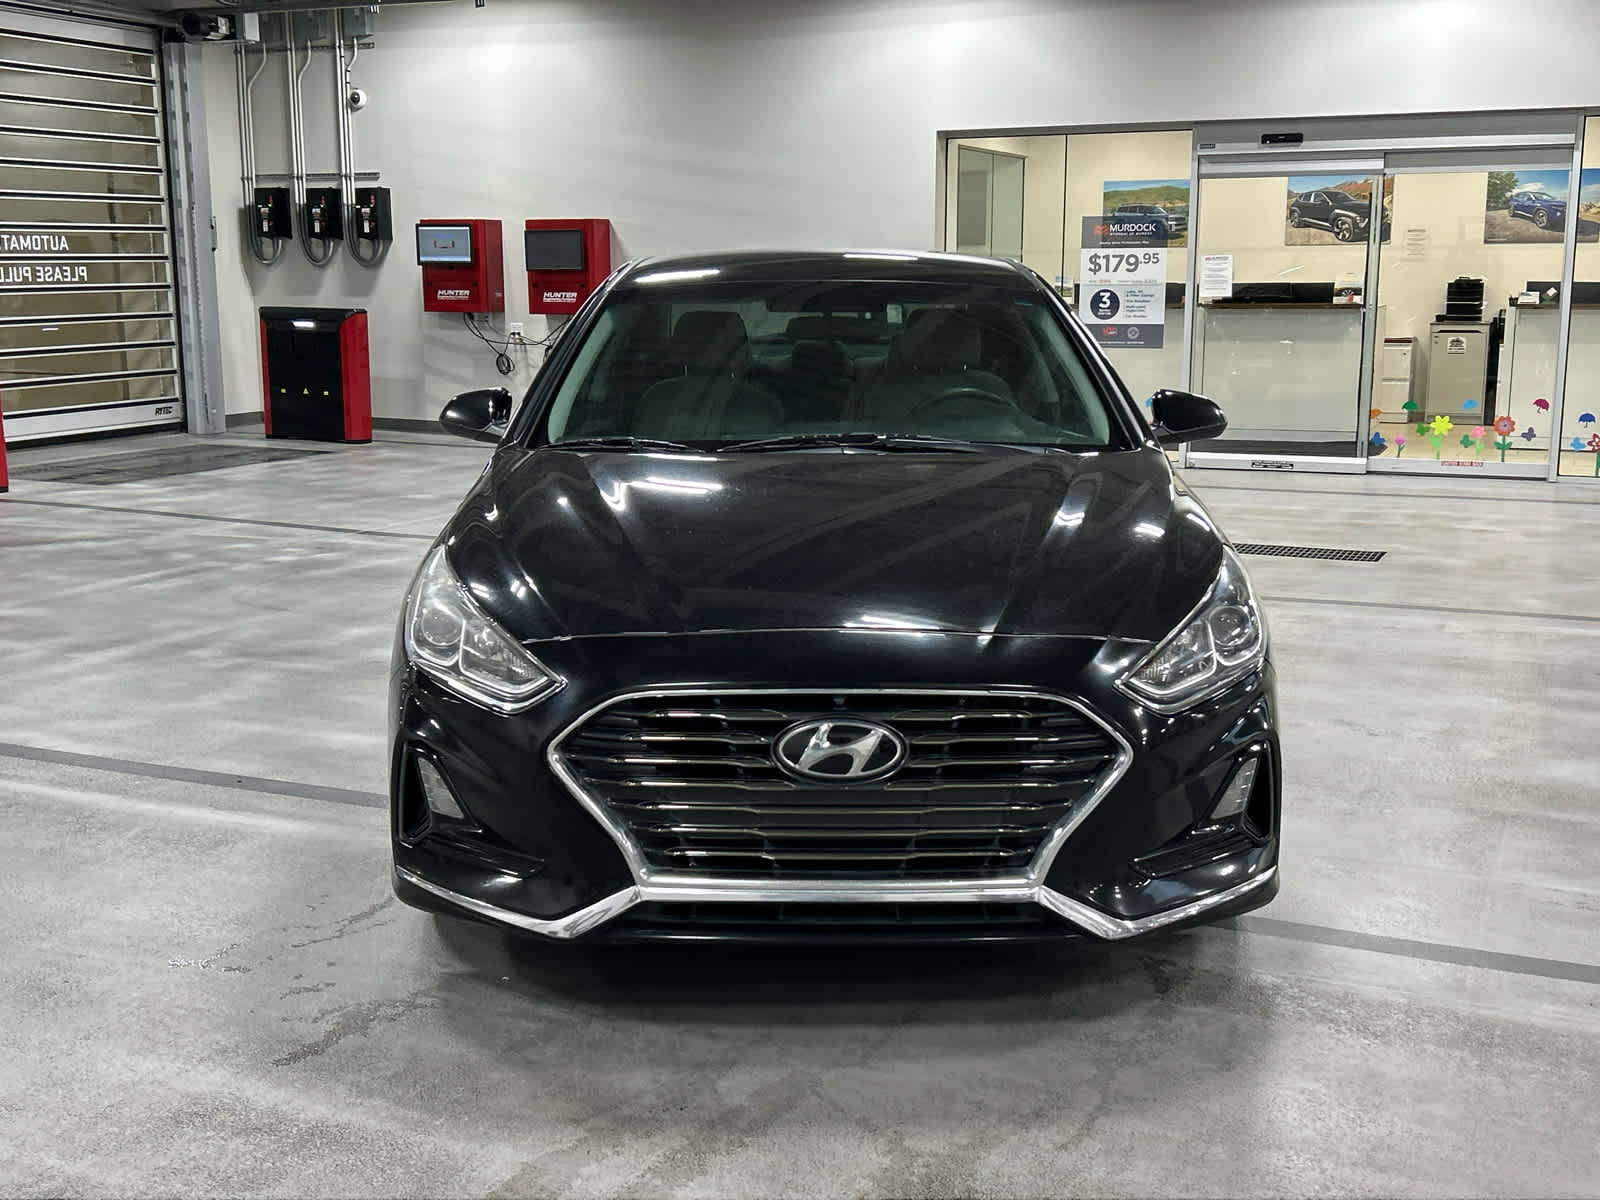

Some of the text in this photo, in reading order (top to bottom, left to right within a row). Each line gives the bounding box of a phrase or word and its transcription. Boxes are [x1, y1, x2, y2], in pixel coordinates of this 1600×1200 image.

[1110, 223, 1156, 232] MURDOCK
[1088, 253, 1160, 275] $179.95
[437, 289, 471, 297] HUNTER
[543, 291, 578, 299] HUNTER
[1099, 292, 1111, 308] 3
